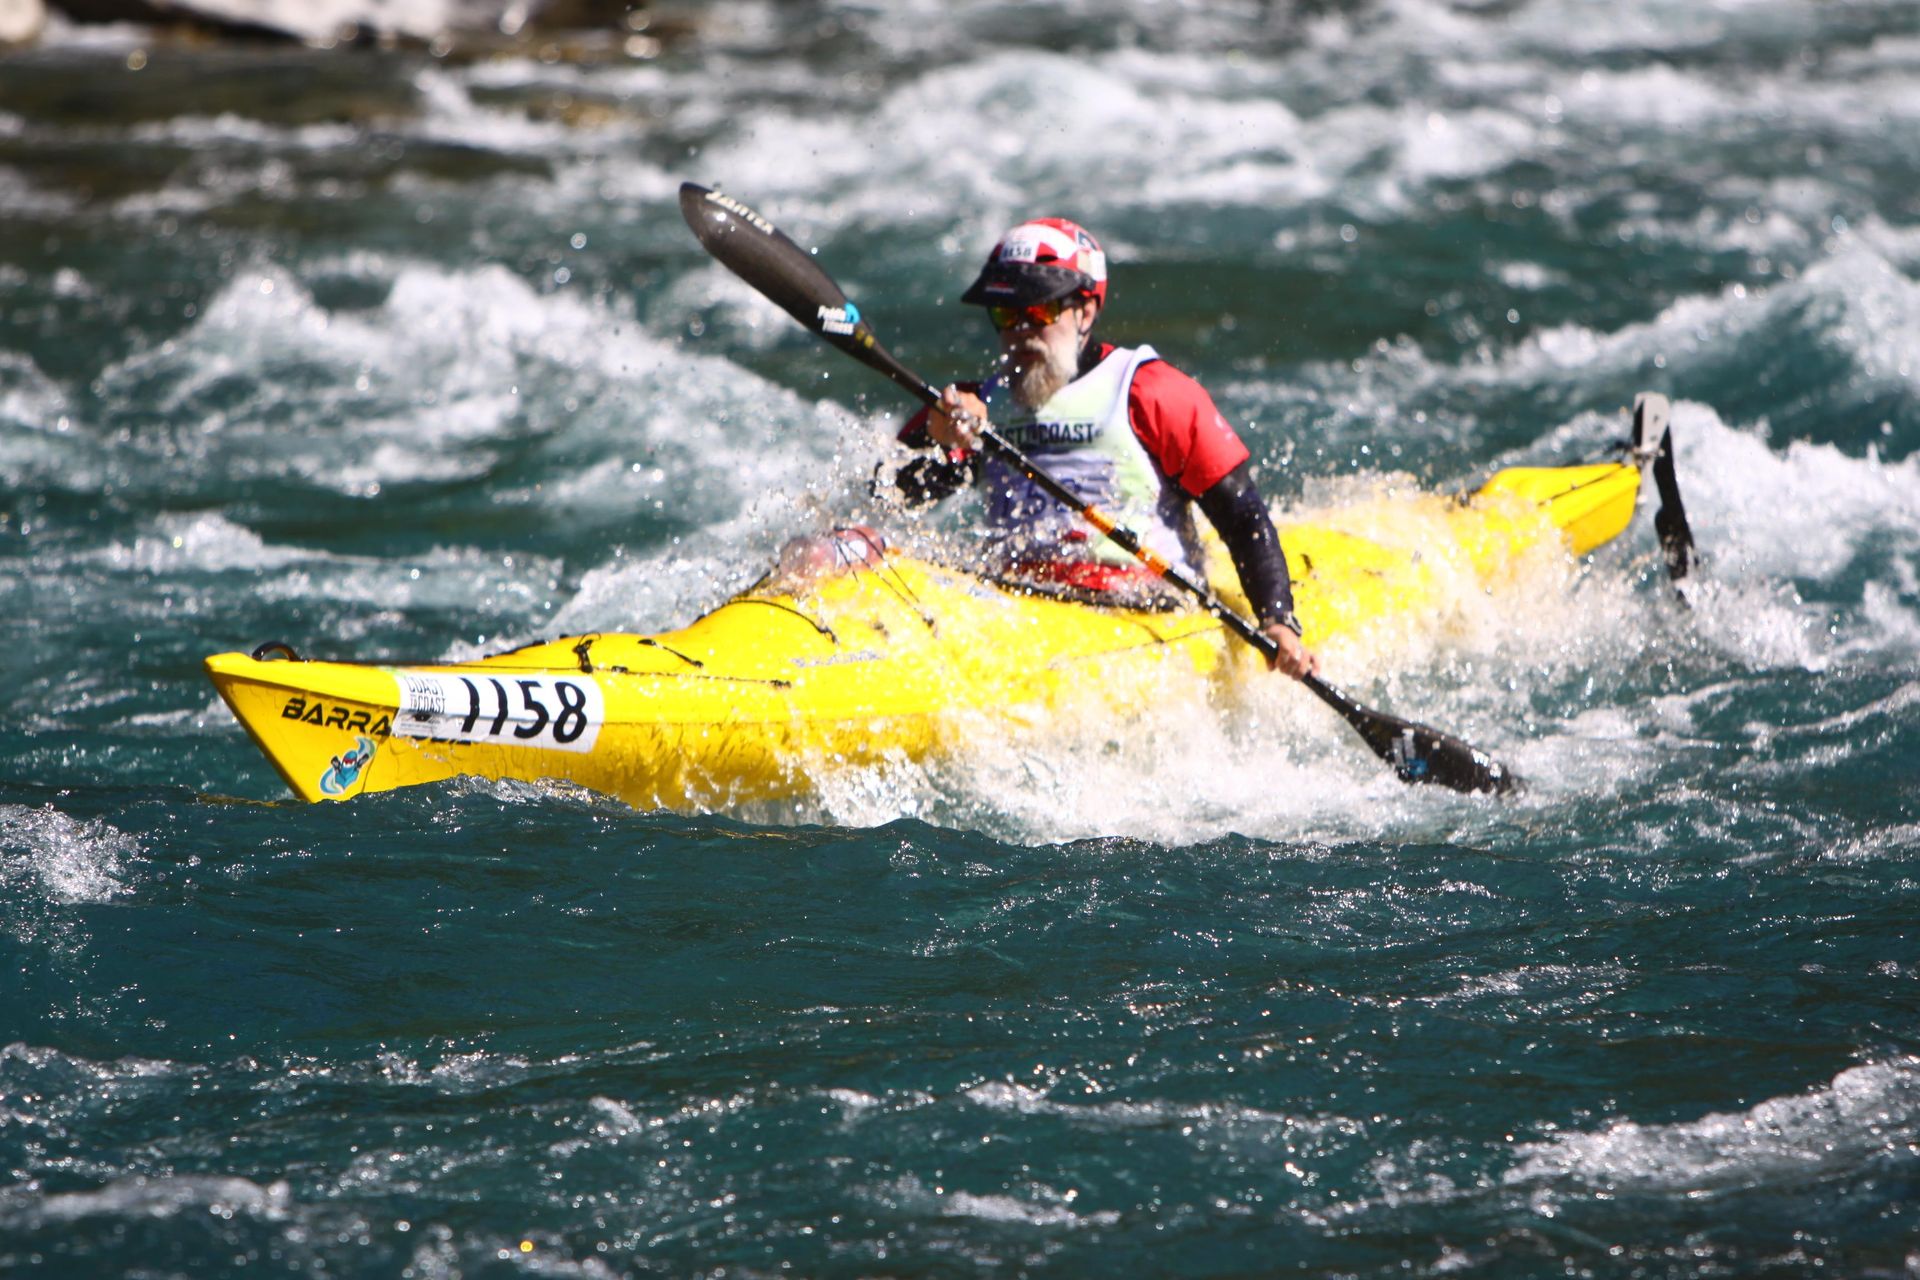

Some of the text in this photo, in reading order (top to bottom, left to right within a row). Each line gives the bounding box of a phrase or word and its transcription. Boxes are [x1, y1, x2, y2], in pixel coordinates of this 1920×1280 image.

[1039, 422, 1094, 444] COAST
[417, 695, 445, 714] COAST
[458, 676, 588, 744] 1158
